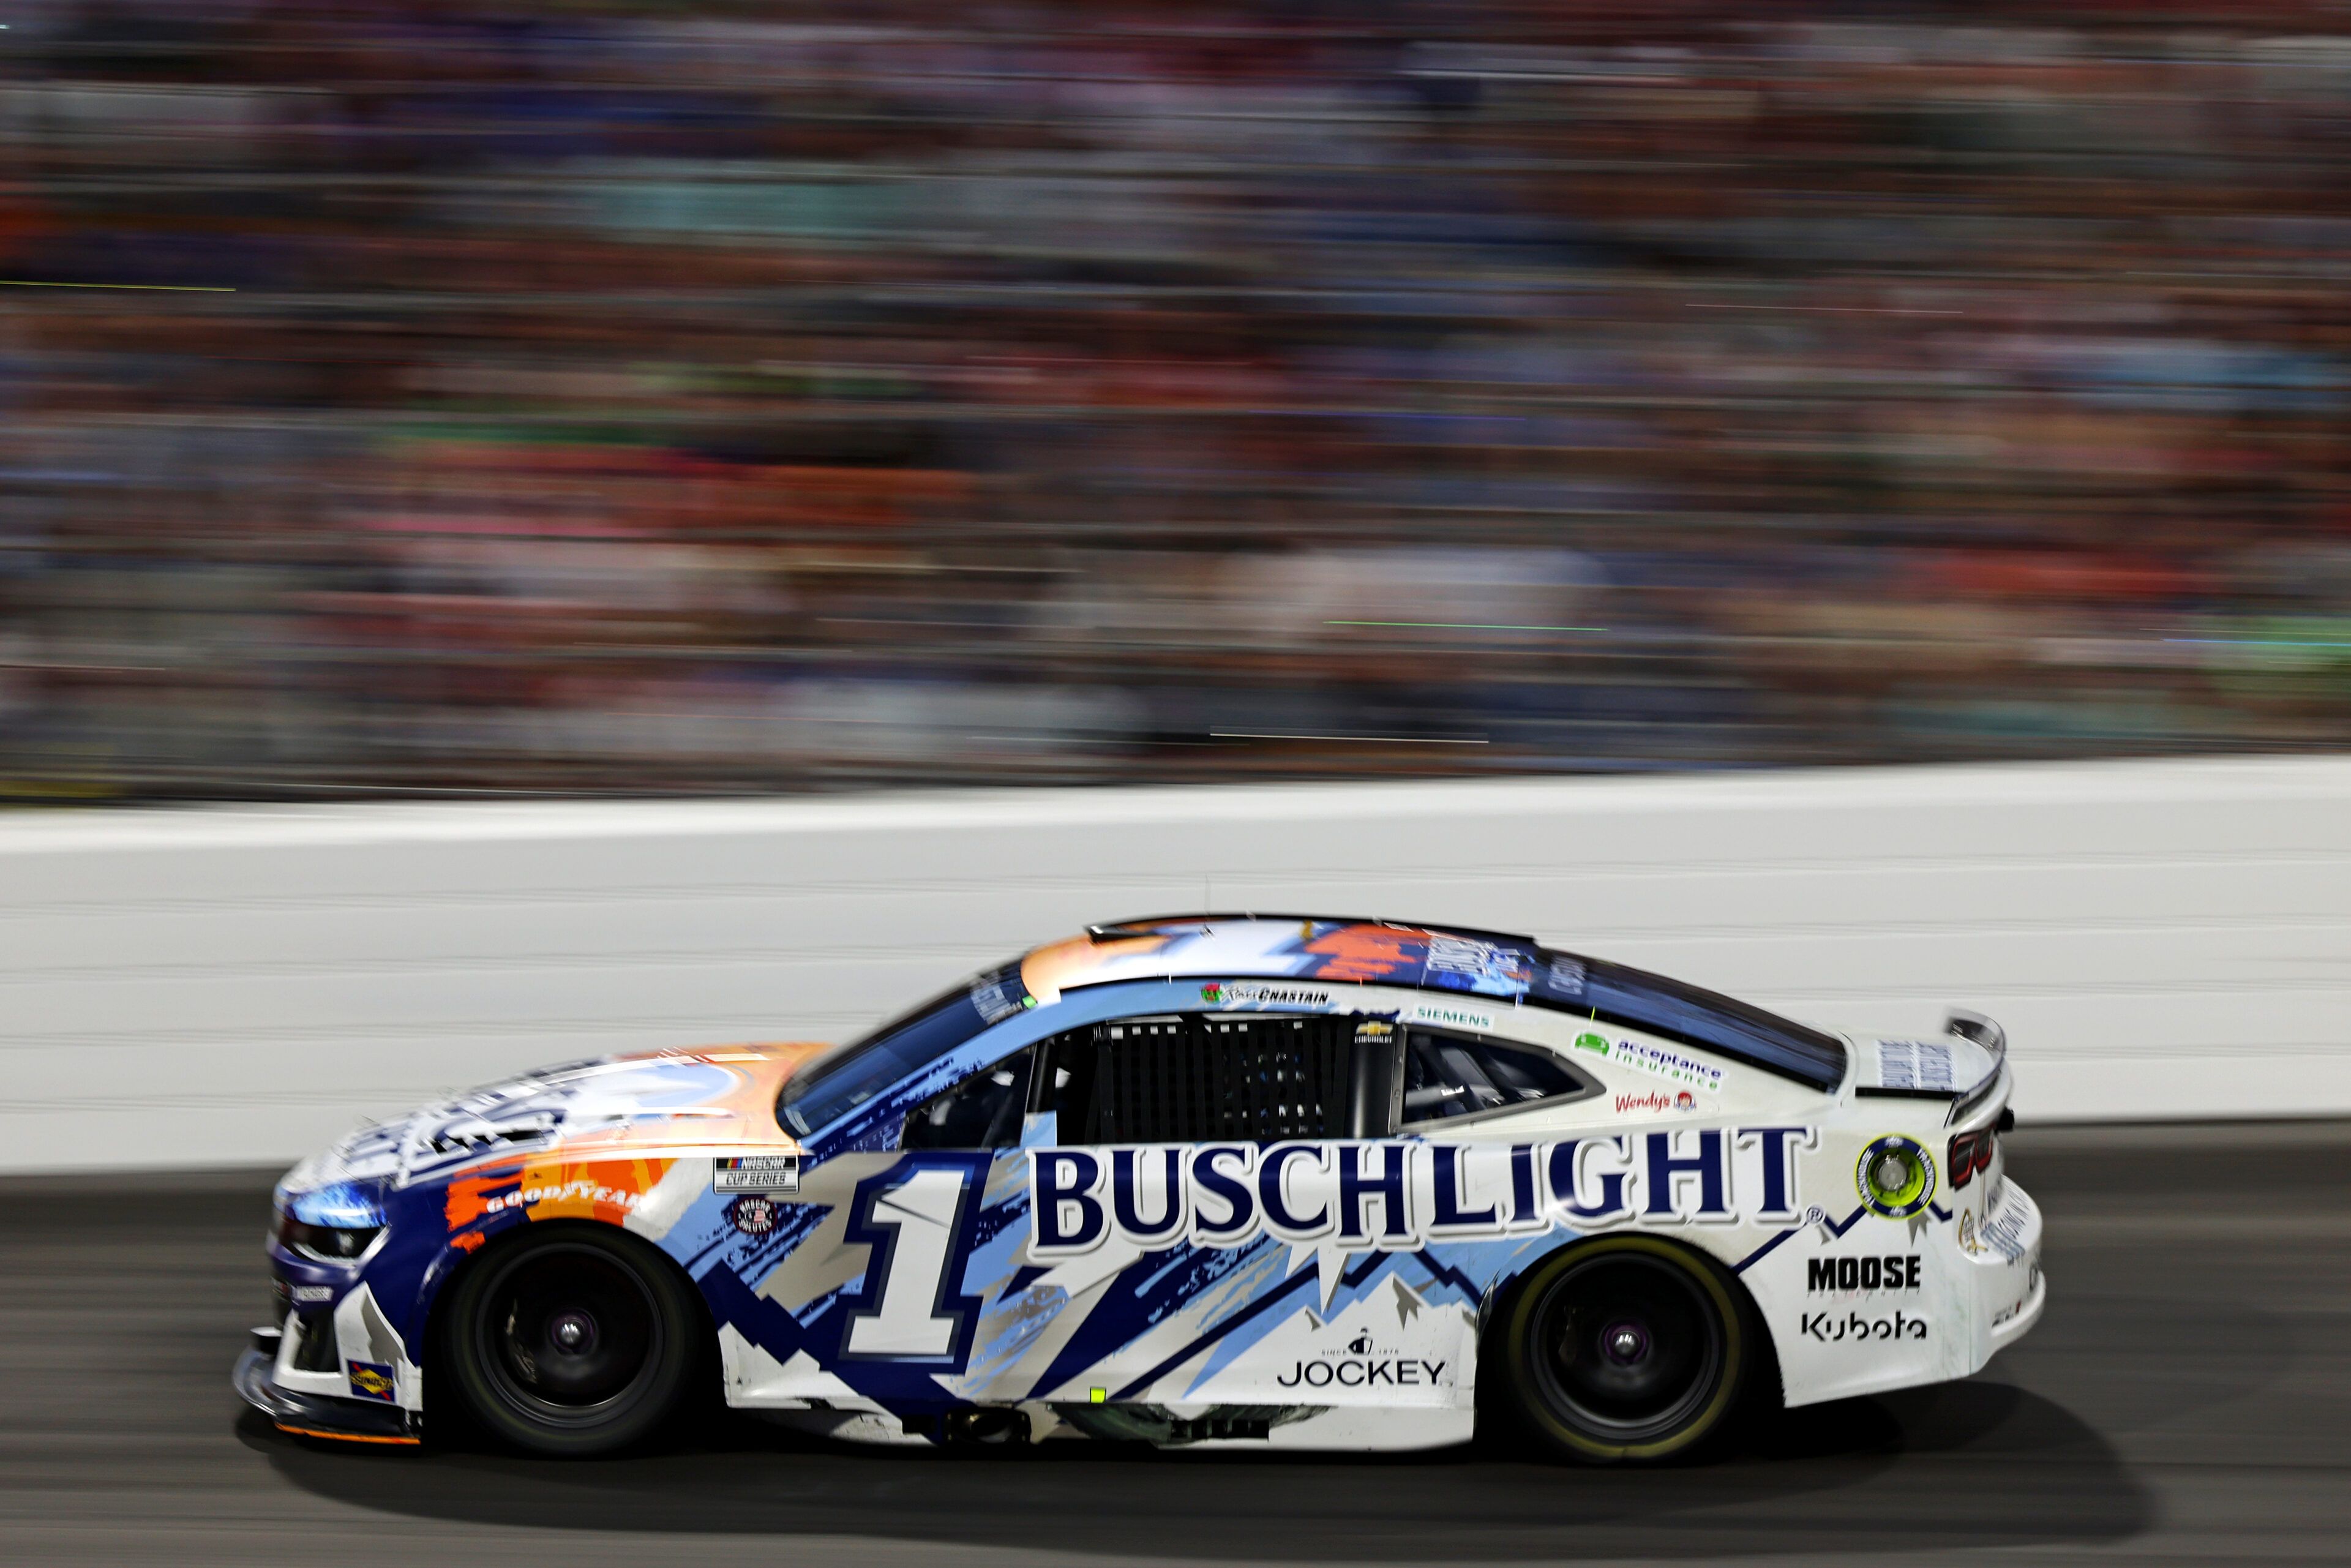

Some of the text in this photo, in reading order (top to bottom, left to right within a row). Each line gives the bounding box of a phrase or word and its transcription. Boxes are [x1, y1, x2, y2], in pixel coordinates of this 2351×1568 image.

[1258, 988, 1329, 1003] CHASTAIN
[1417, 1006, 1490, 1028] SIEMENS
[1354, 1035, 1392, 1044] CHEVROLET
[1615, 1050, 1718, 1090] insurance
[1618, 1041, 1722, 1080] acceptance
[1616, 1090, 1670, 1113] Wendy's
[741, 1157, 786, 1170] NASCAR
[726, 1171, 786, 1186] CUP SERIES
[849, 1170, 966, 1354] 1
[1808, 1255, 1921, 1291] MOOSE
[1801, 1309, 1927, 1342] Kubota
[1277, 1359, 1446, 1387] JOCKEY
